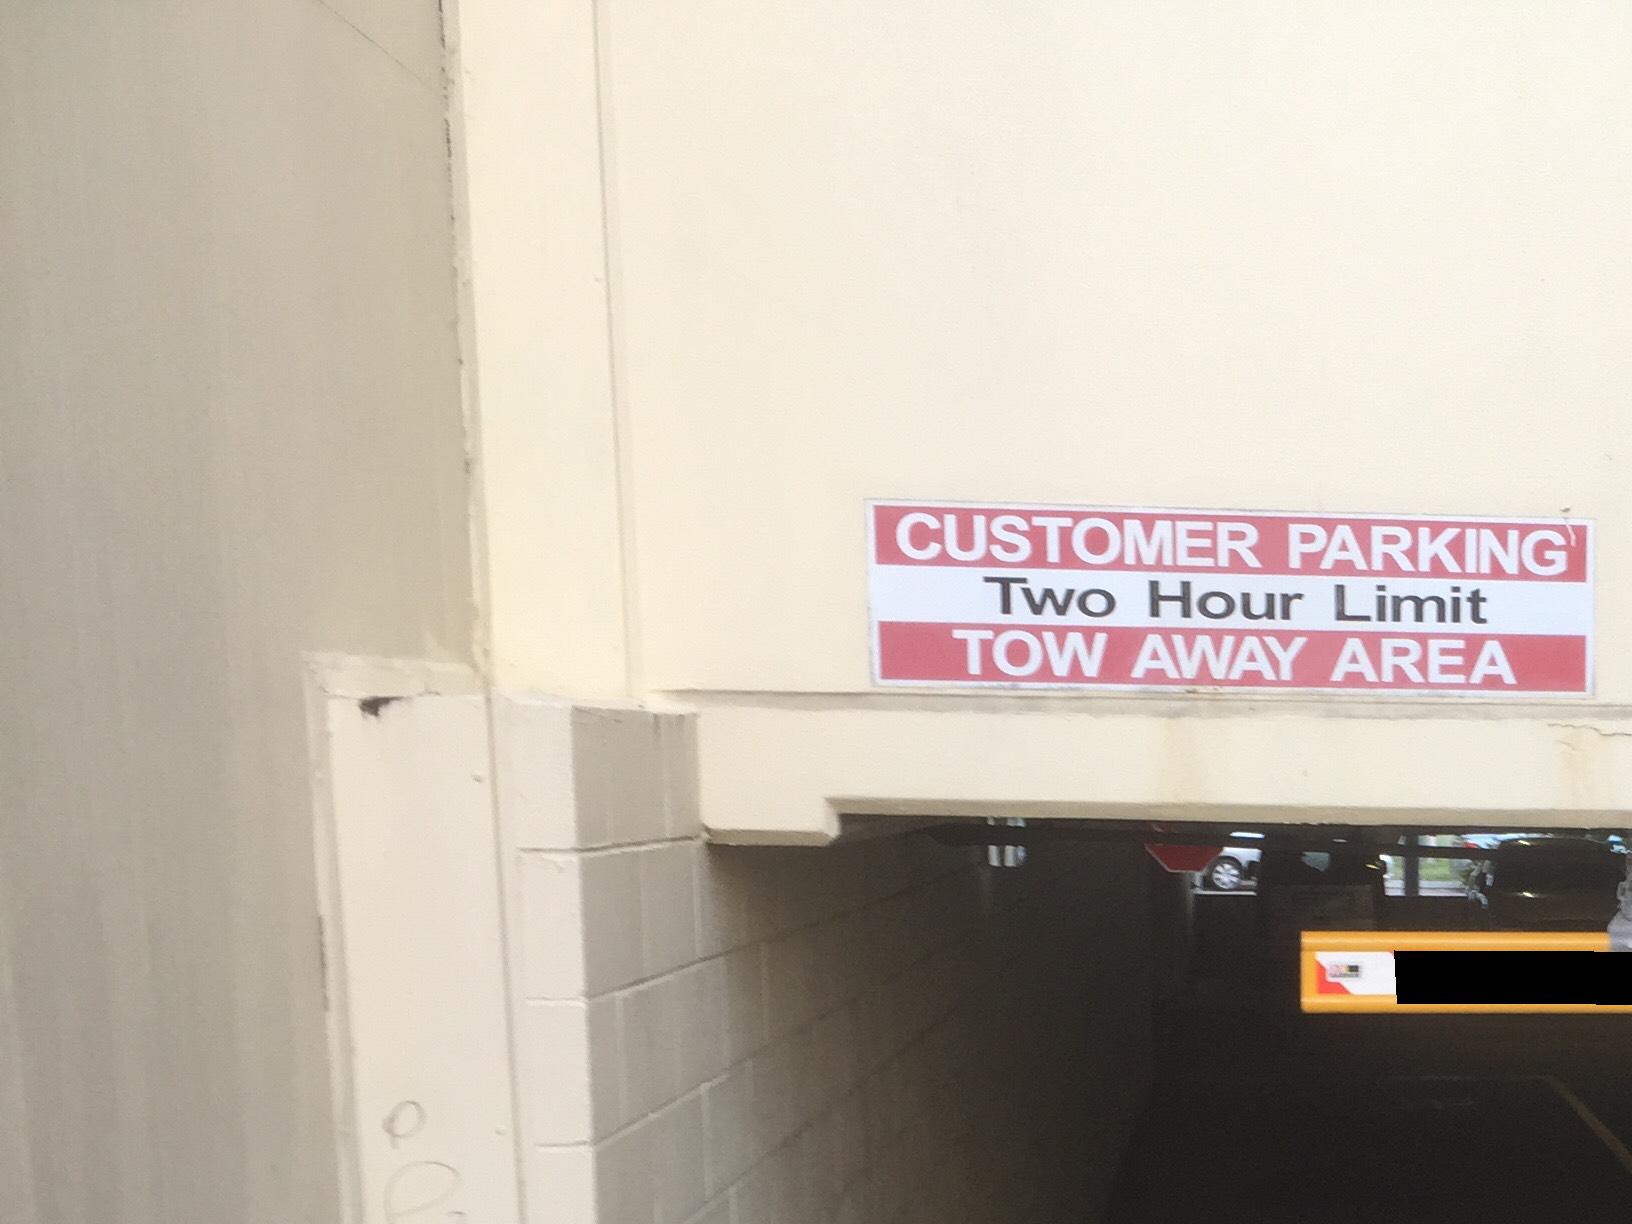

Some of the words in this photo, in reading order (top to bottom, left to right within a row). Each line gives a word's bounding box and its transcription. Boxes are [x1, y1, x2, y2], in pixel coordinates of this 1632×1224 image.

[896, 512, 1262, 568] CUSTOMER
[1288, 523, 1568, 576] PARKING
[983, 576, 1116, 617] Two
[1149, 580, 1304, 622] Hour
[1334, 584, 1488, 624] Limit
[953, 629, 1108, 677] TOW
[1131, 634, 1308, 680] AWAY
[1330, 638, 1517, 685] AREA
